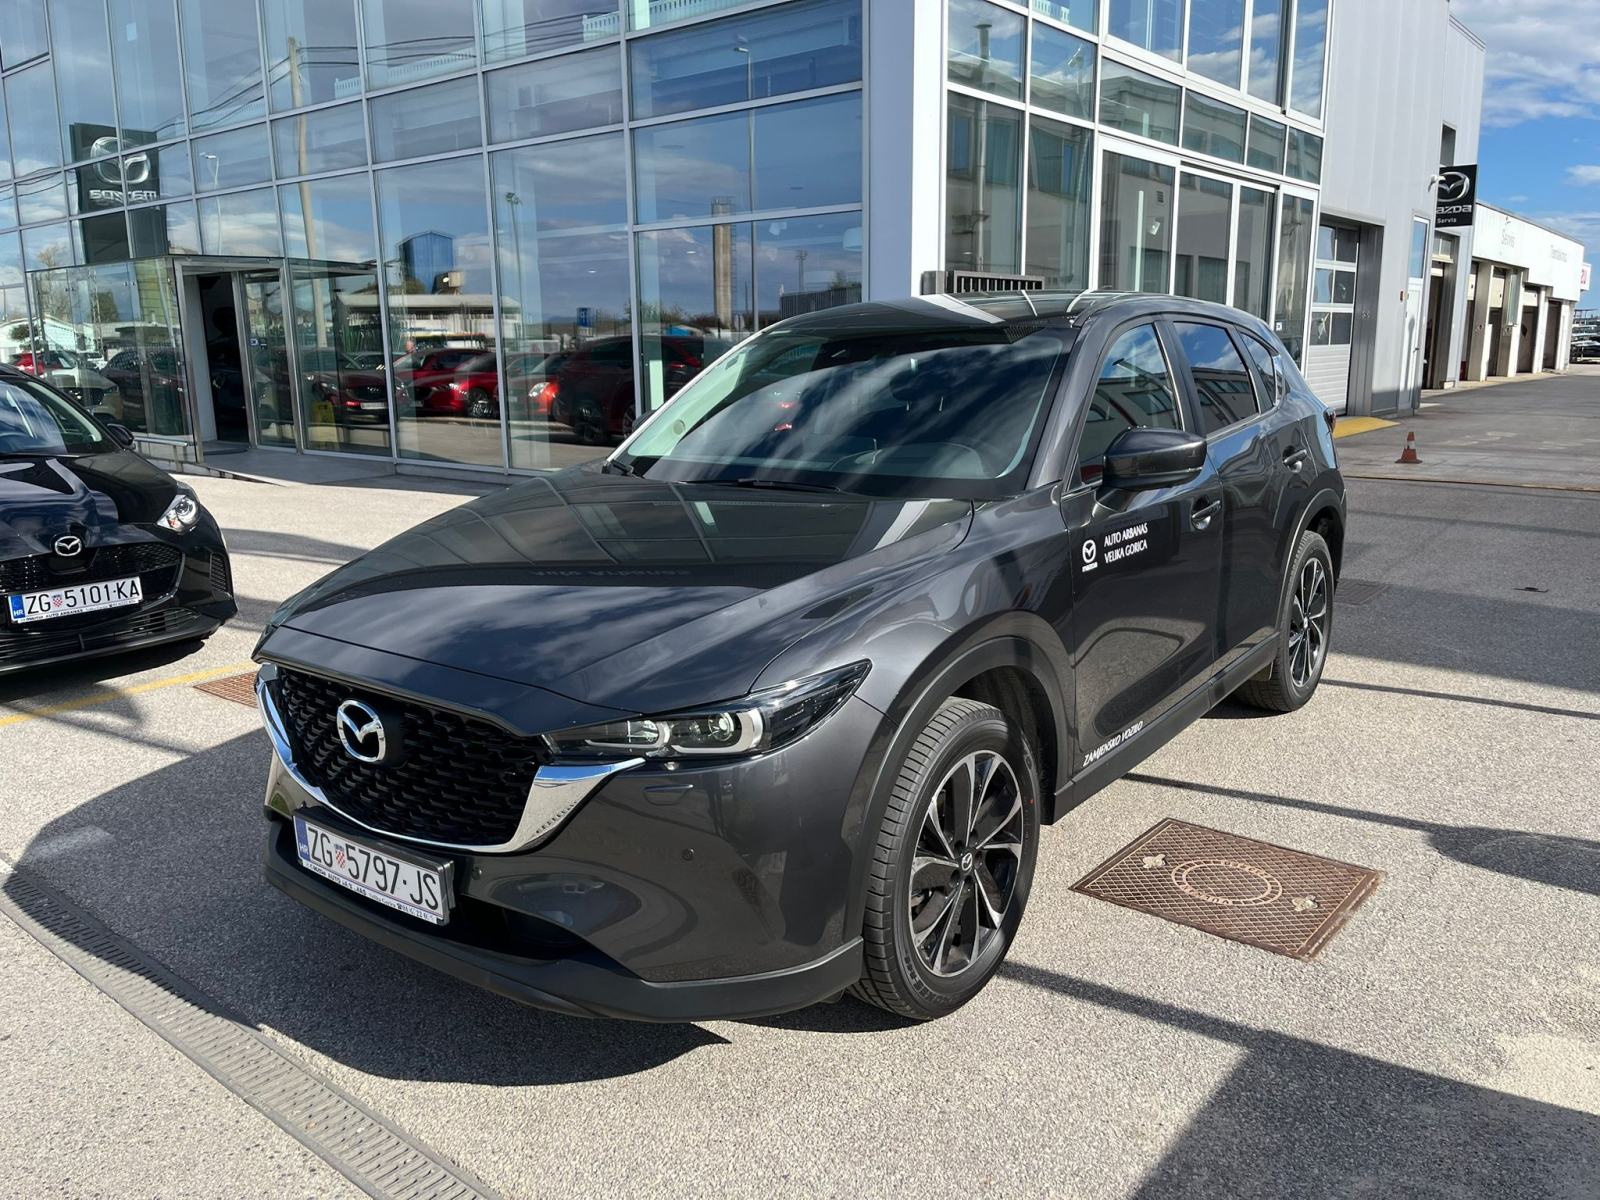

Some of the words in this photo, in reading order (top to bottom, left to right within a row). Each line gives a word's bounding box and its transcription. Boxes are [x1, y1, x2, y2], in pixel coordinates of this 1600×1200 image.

[1436, 204, 1472, 215] azda
[1104, 531, 1122, 548] AUTO
[1121, 522, 1149, 541] ARBANAS
[1104, 547, 1125, 564] VELIKA
[1125, 539, 1149, 557] GORICA
[25, 593, 52, 615] ZG
[308, 827, 334, 868] ZG
